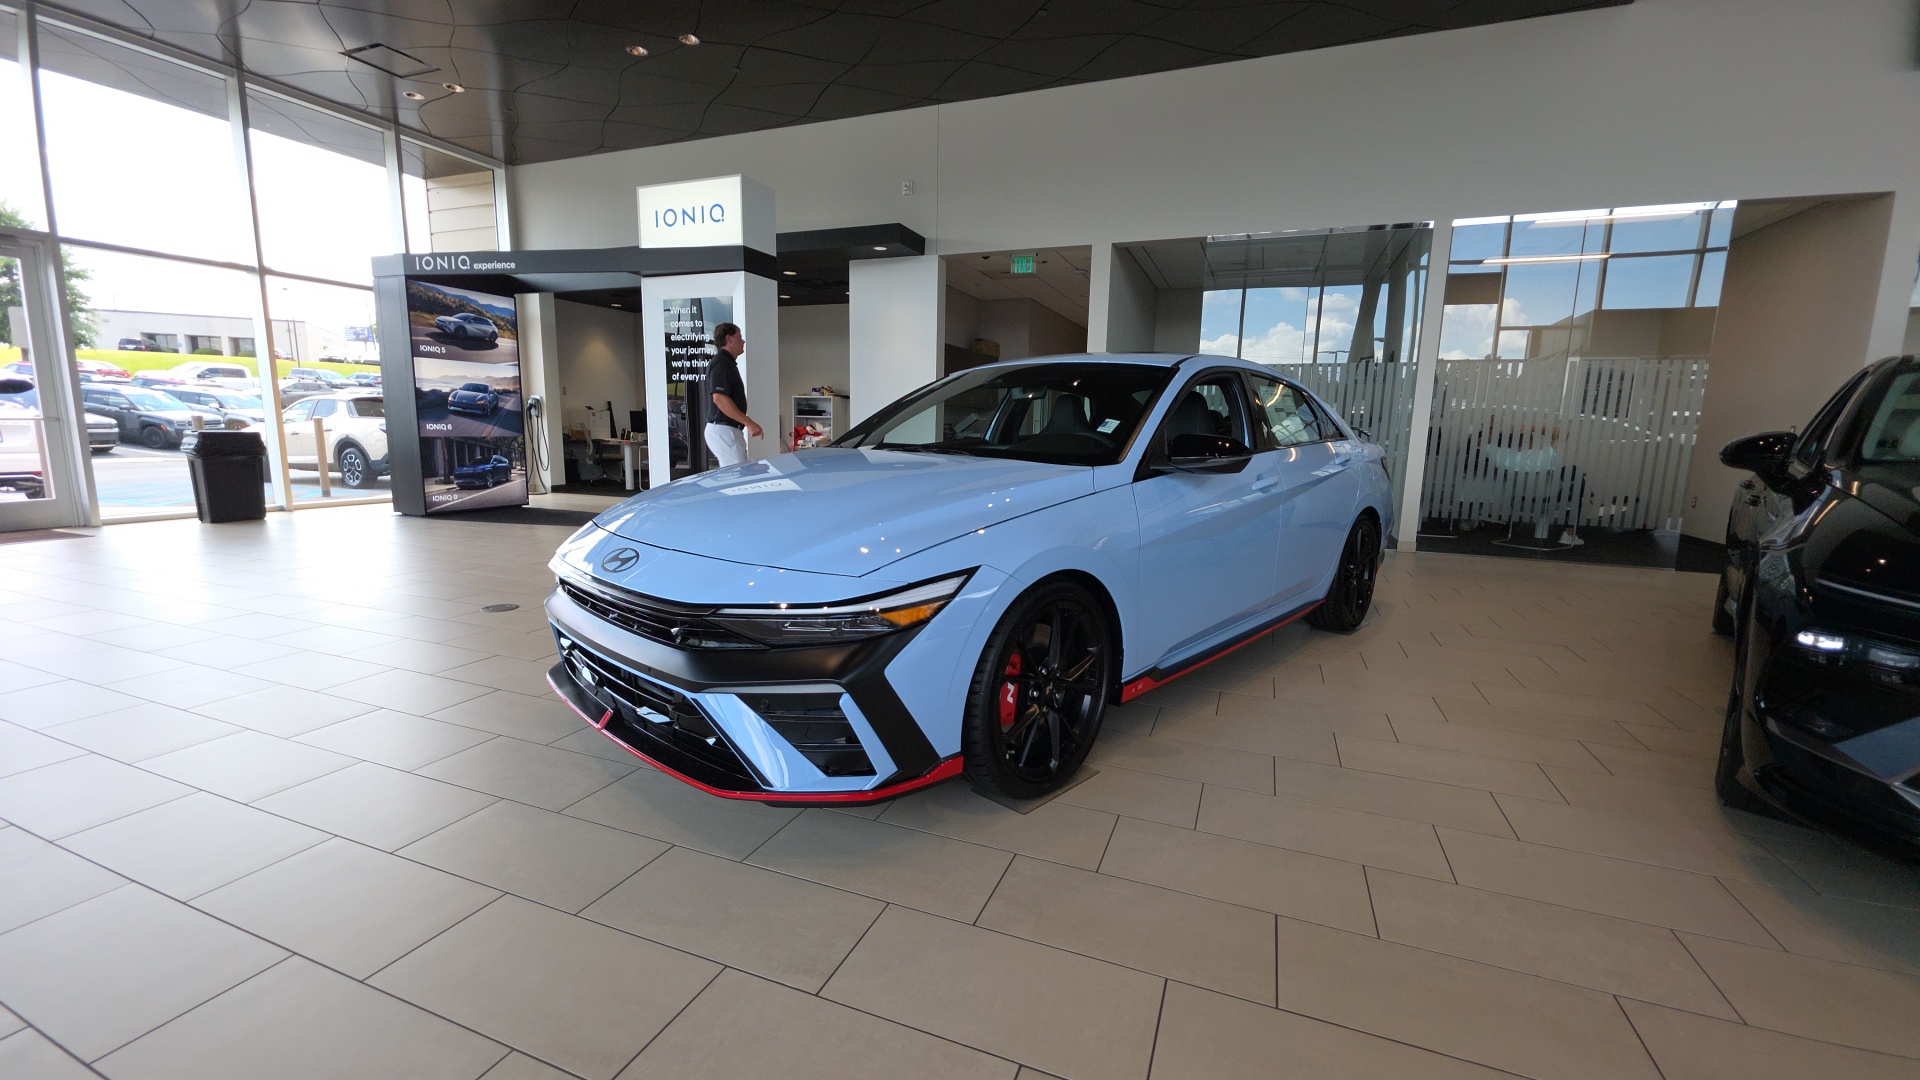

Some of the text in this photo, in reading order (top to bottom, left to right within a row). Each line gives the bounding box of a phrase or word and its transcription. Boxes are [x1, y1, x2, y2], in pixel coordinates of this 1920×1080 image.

[655, 203, 725, 228] IONIQ
[415, 255, 516, 271] IONIQ experience
[670, 305, 697, 314] When it
[670, 319, 703, 328] comes to
[670, 332, 710, 342] electrifying
[419, 344, 446, 354] IONIQ 5
[671, 347, 687, 356] your
[671, 359, 691, 368] we're
[672, 372, 680, 381] of
[680, 373, 700, 382] every
[426, 423, 447, 431] IONIQ
[432, 494, 453, 502] IONIQ
